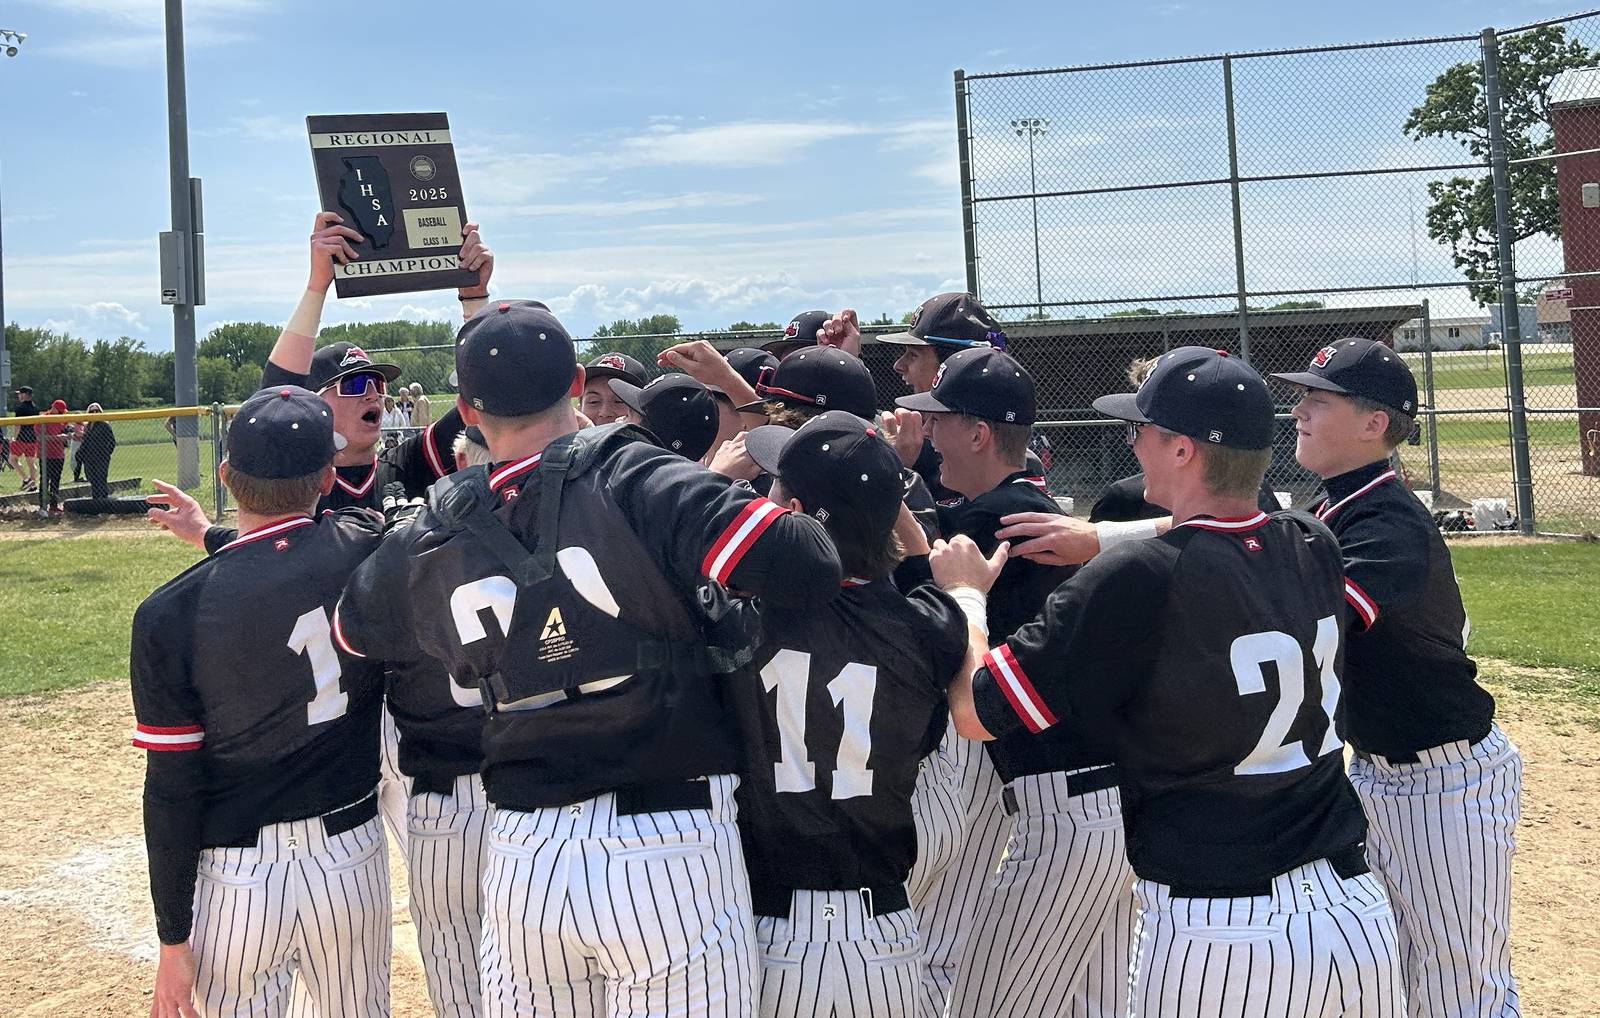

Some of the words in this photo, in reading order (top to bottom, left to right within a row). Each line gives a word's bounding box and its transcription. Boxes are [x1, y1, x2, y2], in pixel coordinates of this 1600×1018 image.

[330, 131, 437, 146] REGIONAL
[409, 187, 448, 201] 2025
[418, 217, 447, 228] BASEBALL
[423, 237, 439, 246] CLASS
[441, 236, 449, 245] 1A
[343, 256, 457, 276] CHAMPION
[286, 605, 349, 726] 1
[1230, 614, 1344, 776] 21
[759, 648, 877, 800] 11
